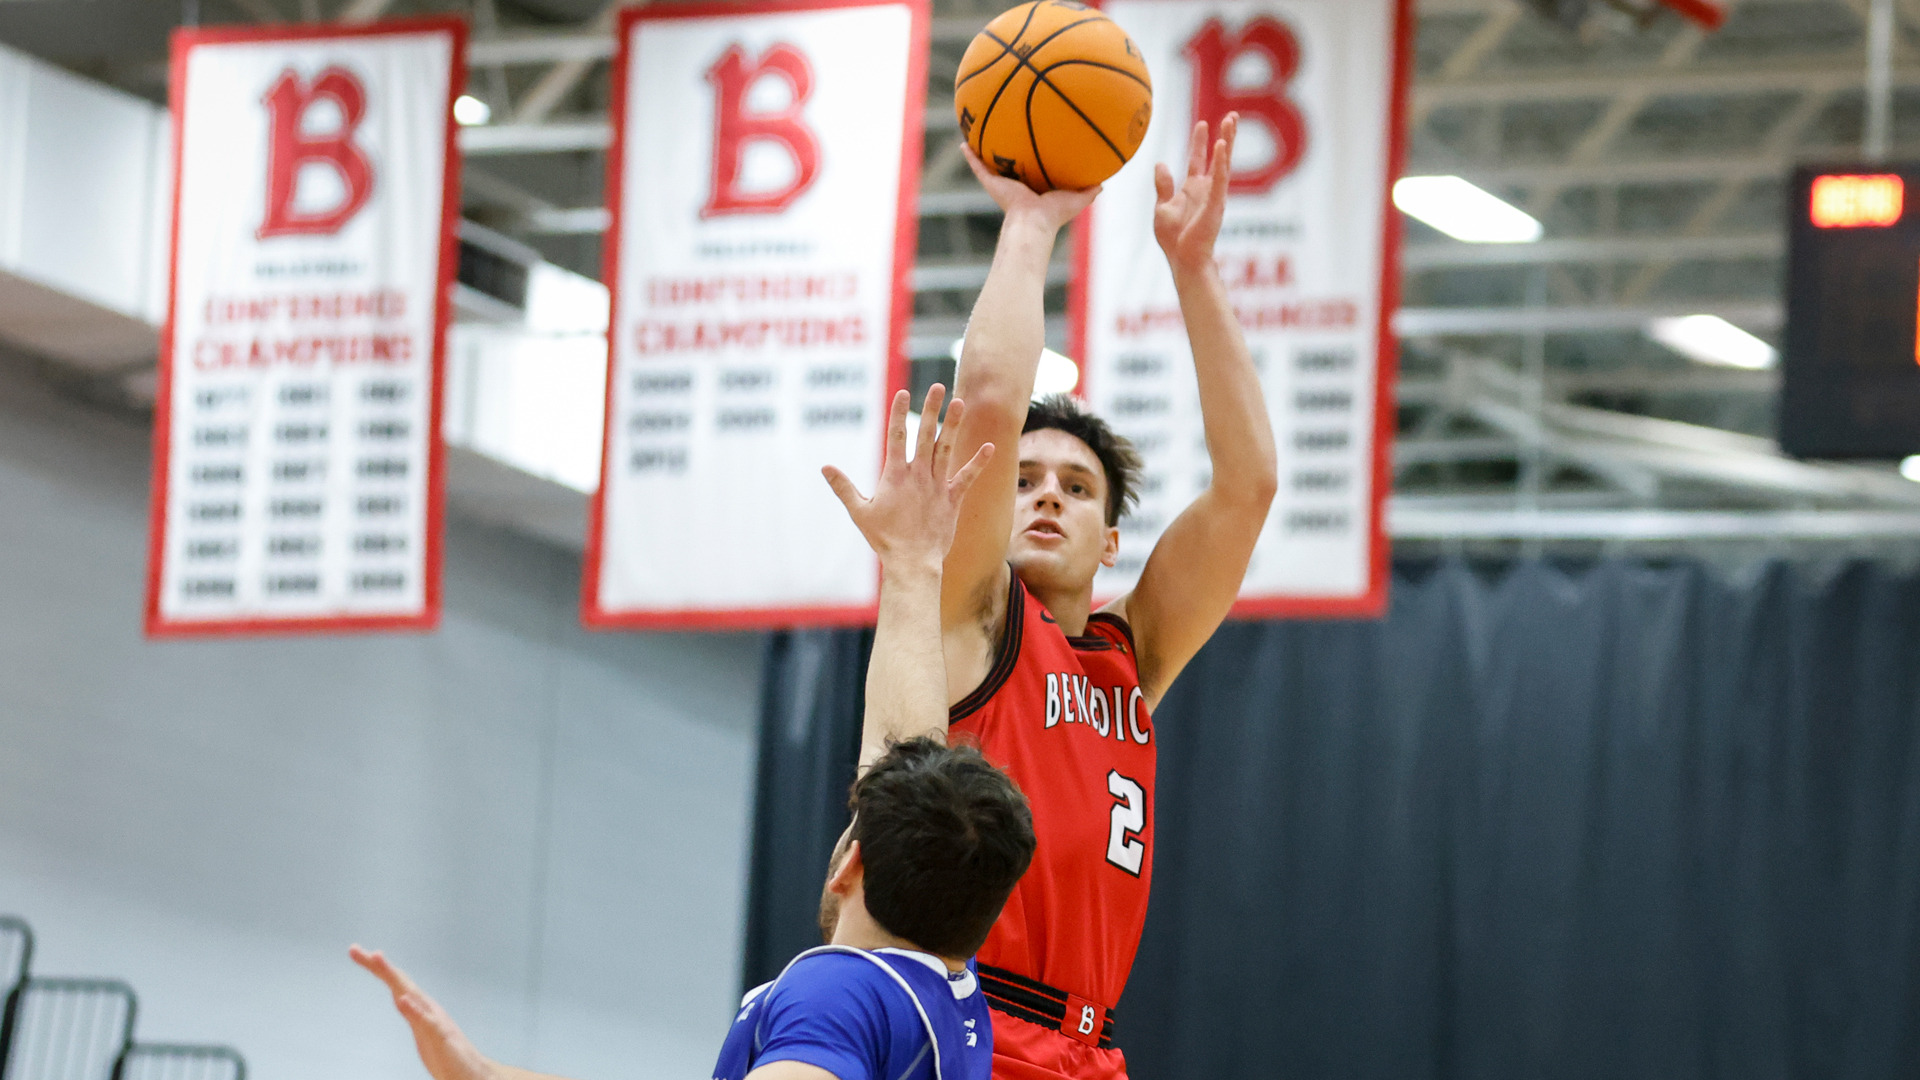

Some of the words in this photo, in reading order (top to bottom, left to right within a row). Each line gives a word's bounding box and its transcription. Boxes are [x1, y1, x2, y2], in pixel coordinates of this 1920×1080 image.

[256, 66, 375, 241] B
[699, 42, 822, 219] B
[1181, 16, 1307, 195] B
[194, 333, 412, 370] CHAMPIONS
[635, 314, 865, 356] CHAMPIONS
[1105, 768, 1146, 879] 2
[1077, 1004, 1095, 1035] B
